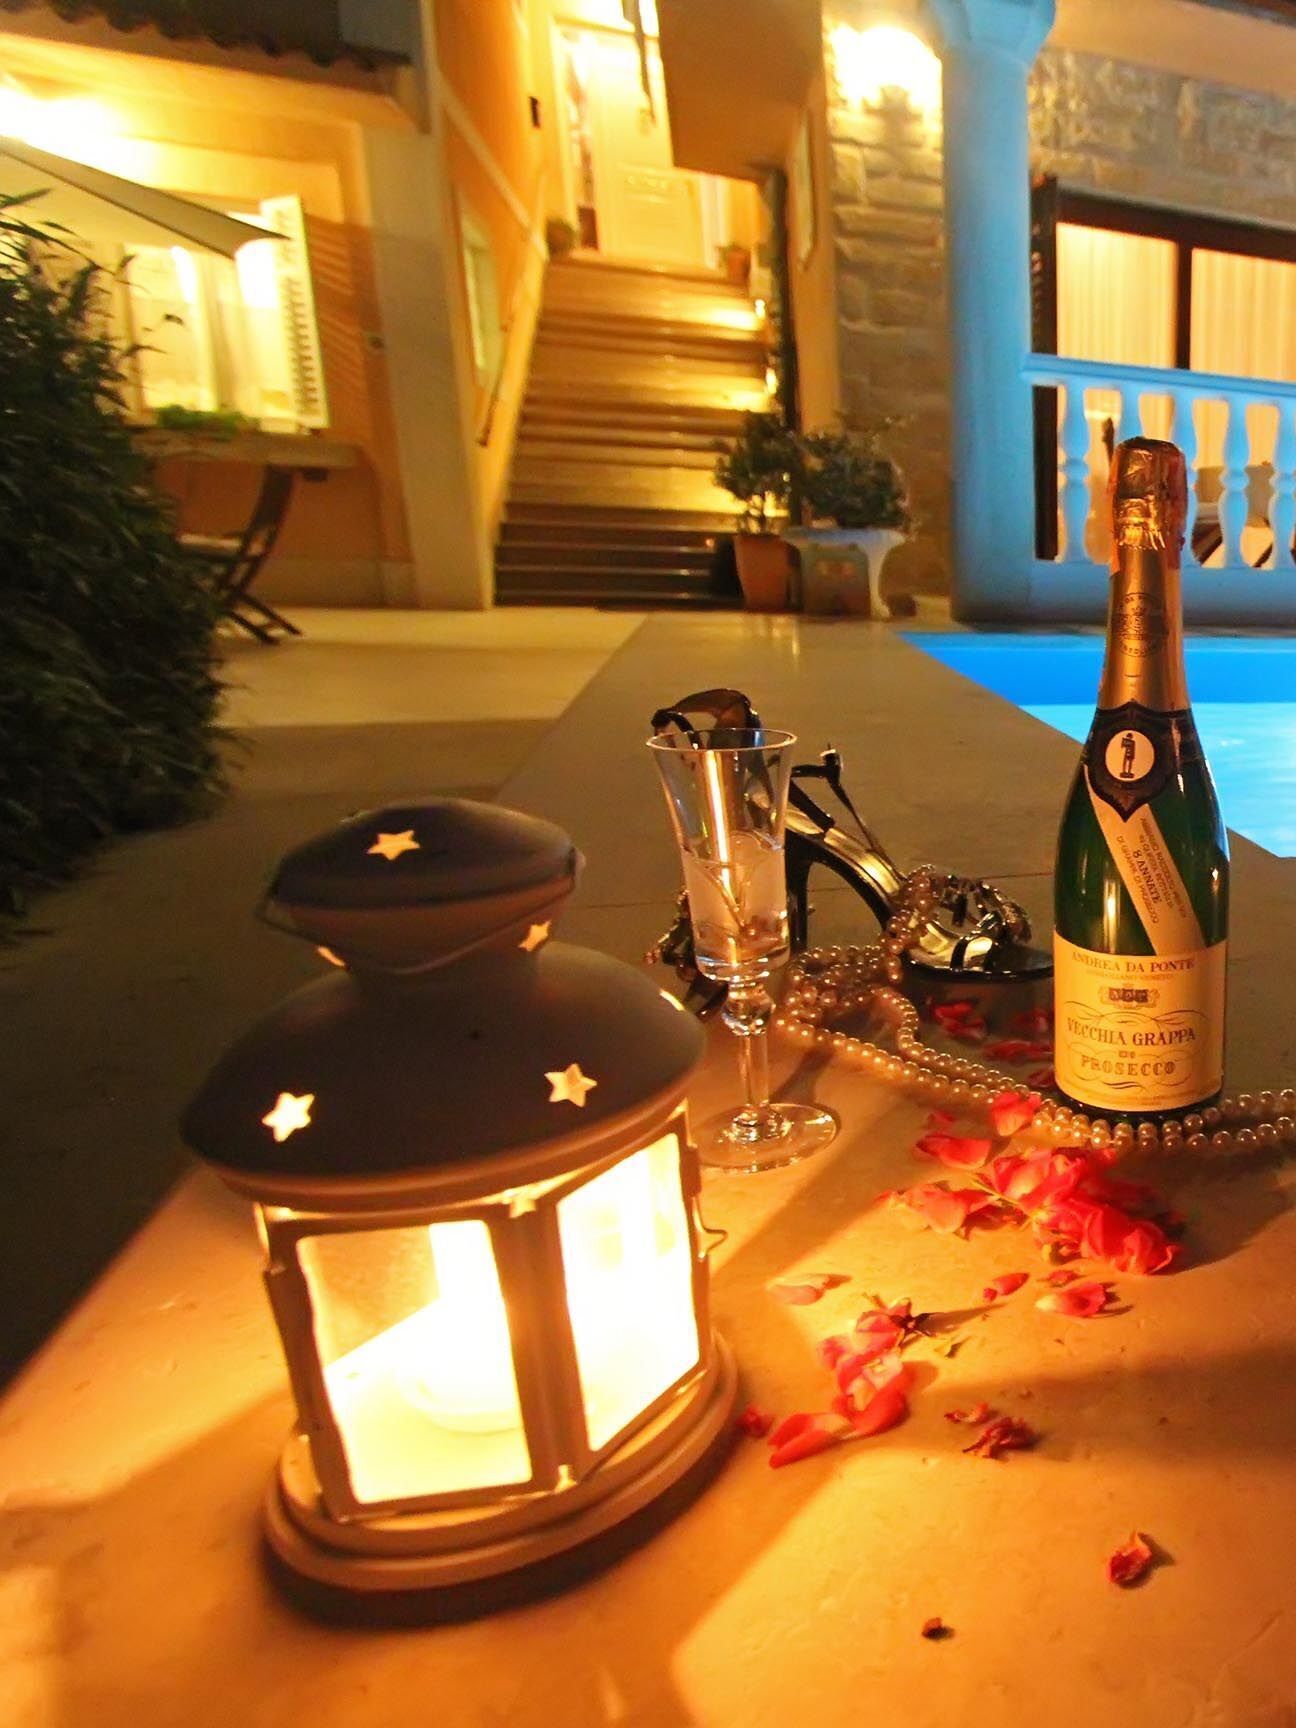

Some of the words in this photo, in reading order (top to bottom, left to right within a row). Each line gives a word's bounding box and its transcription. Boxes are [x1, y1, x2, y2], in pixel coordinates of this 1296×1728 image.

[1132, 849, 1142, 859] 8
[1136, 859, 1163, 905] ANNATE
[1071, 951, 1120, 972] ANDREA
[1126, 961, 1145, 973] DA
[1150, 959, 1194, 972] PONTE
[1066, 1016, 1127, 1046] VECCHIA
[1132, 1026, 1196, 1047] GRAPPA
[1080, 1054, 1177, 1077] PROSECCO
